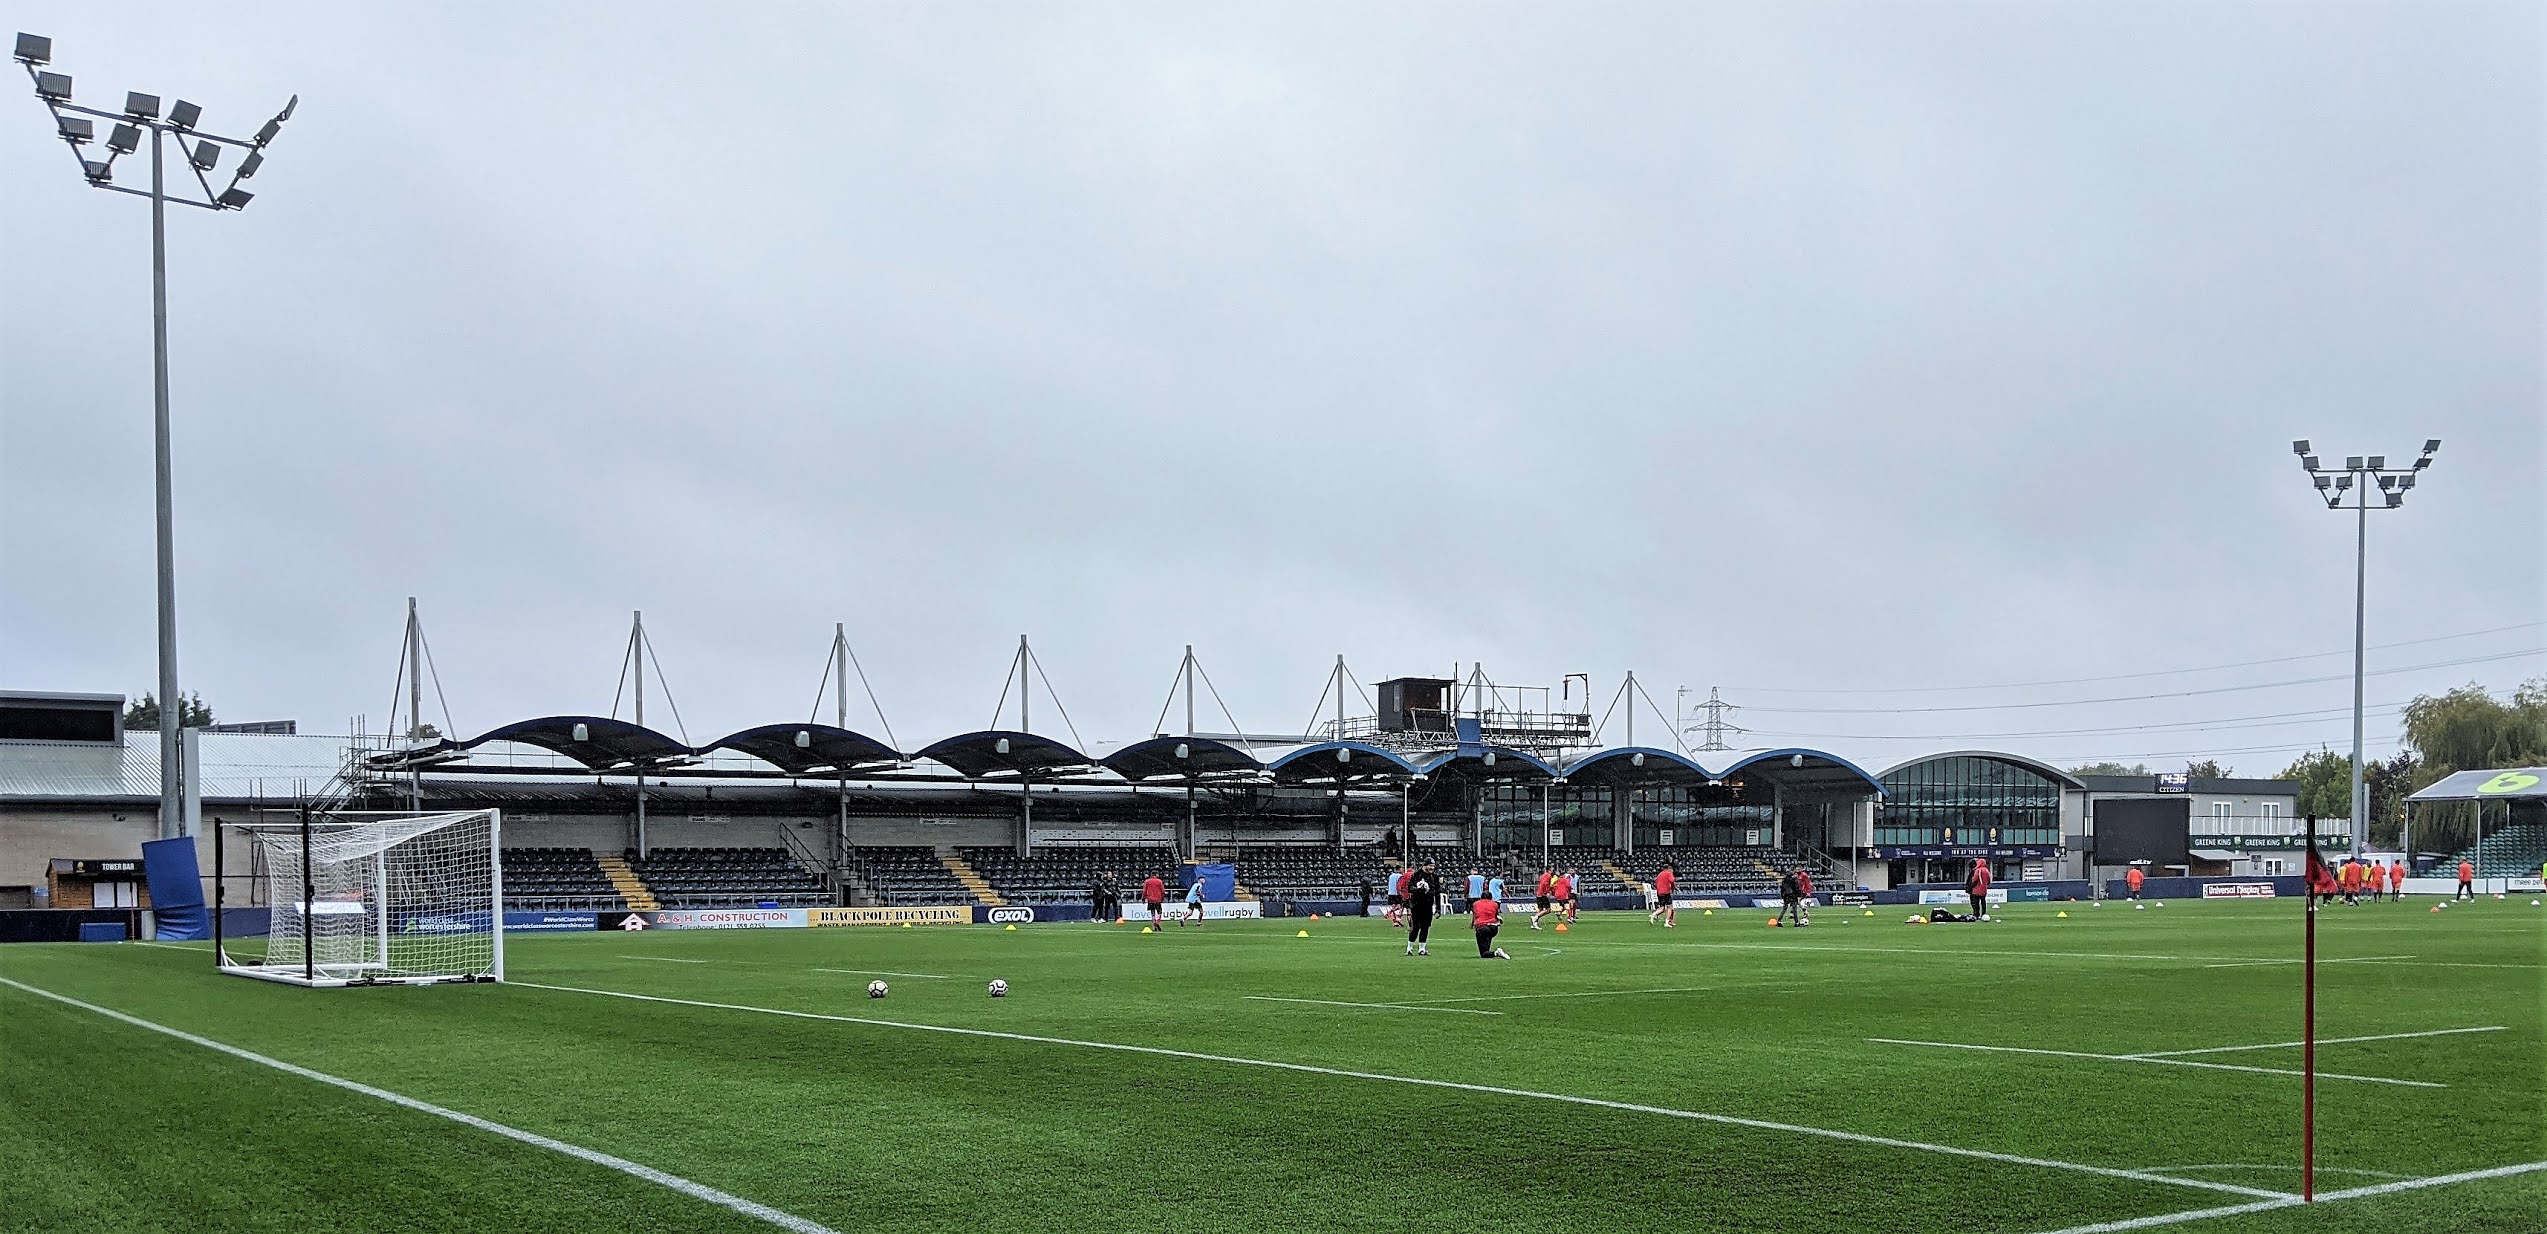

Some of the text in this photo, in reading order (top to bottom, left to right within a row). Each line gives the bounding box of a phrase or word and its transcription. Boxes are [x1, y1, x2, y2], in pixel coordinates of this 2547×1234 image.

[2194, 838, 2232, 846] GREENE KING
[2244, 838, 2281, 846] GREENE KING
[102, 862, 135, 871] TOWER BAR
[2208, 885, 2236, 895] Universal
[2236, 885, 2260, 896] Display
[672, 914, 681, 924] &
[700, 912, 788, 922] CONSTRUCTION
[821, 909, 960, 921] BLACKPOLE RECYCLING
[418, 923, 471, 931] worcestershire
